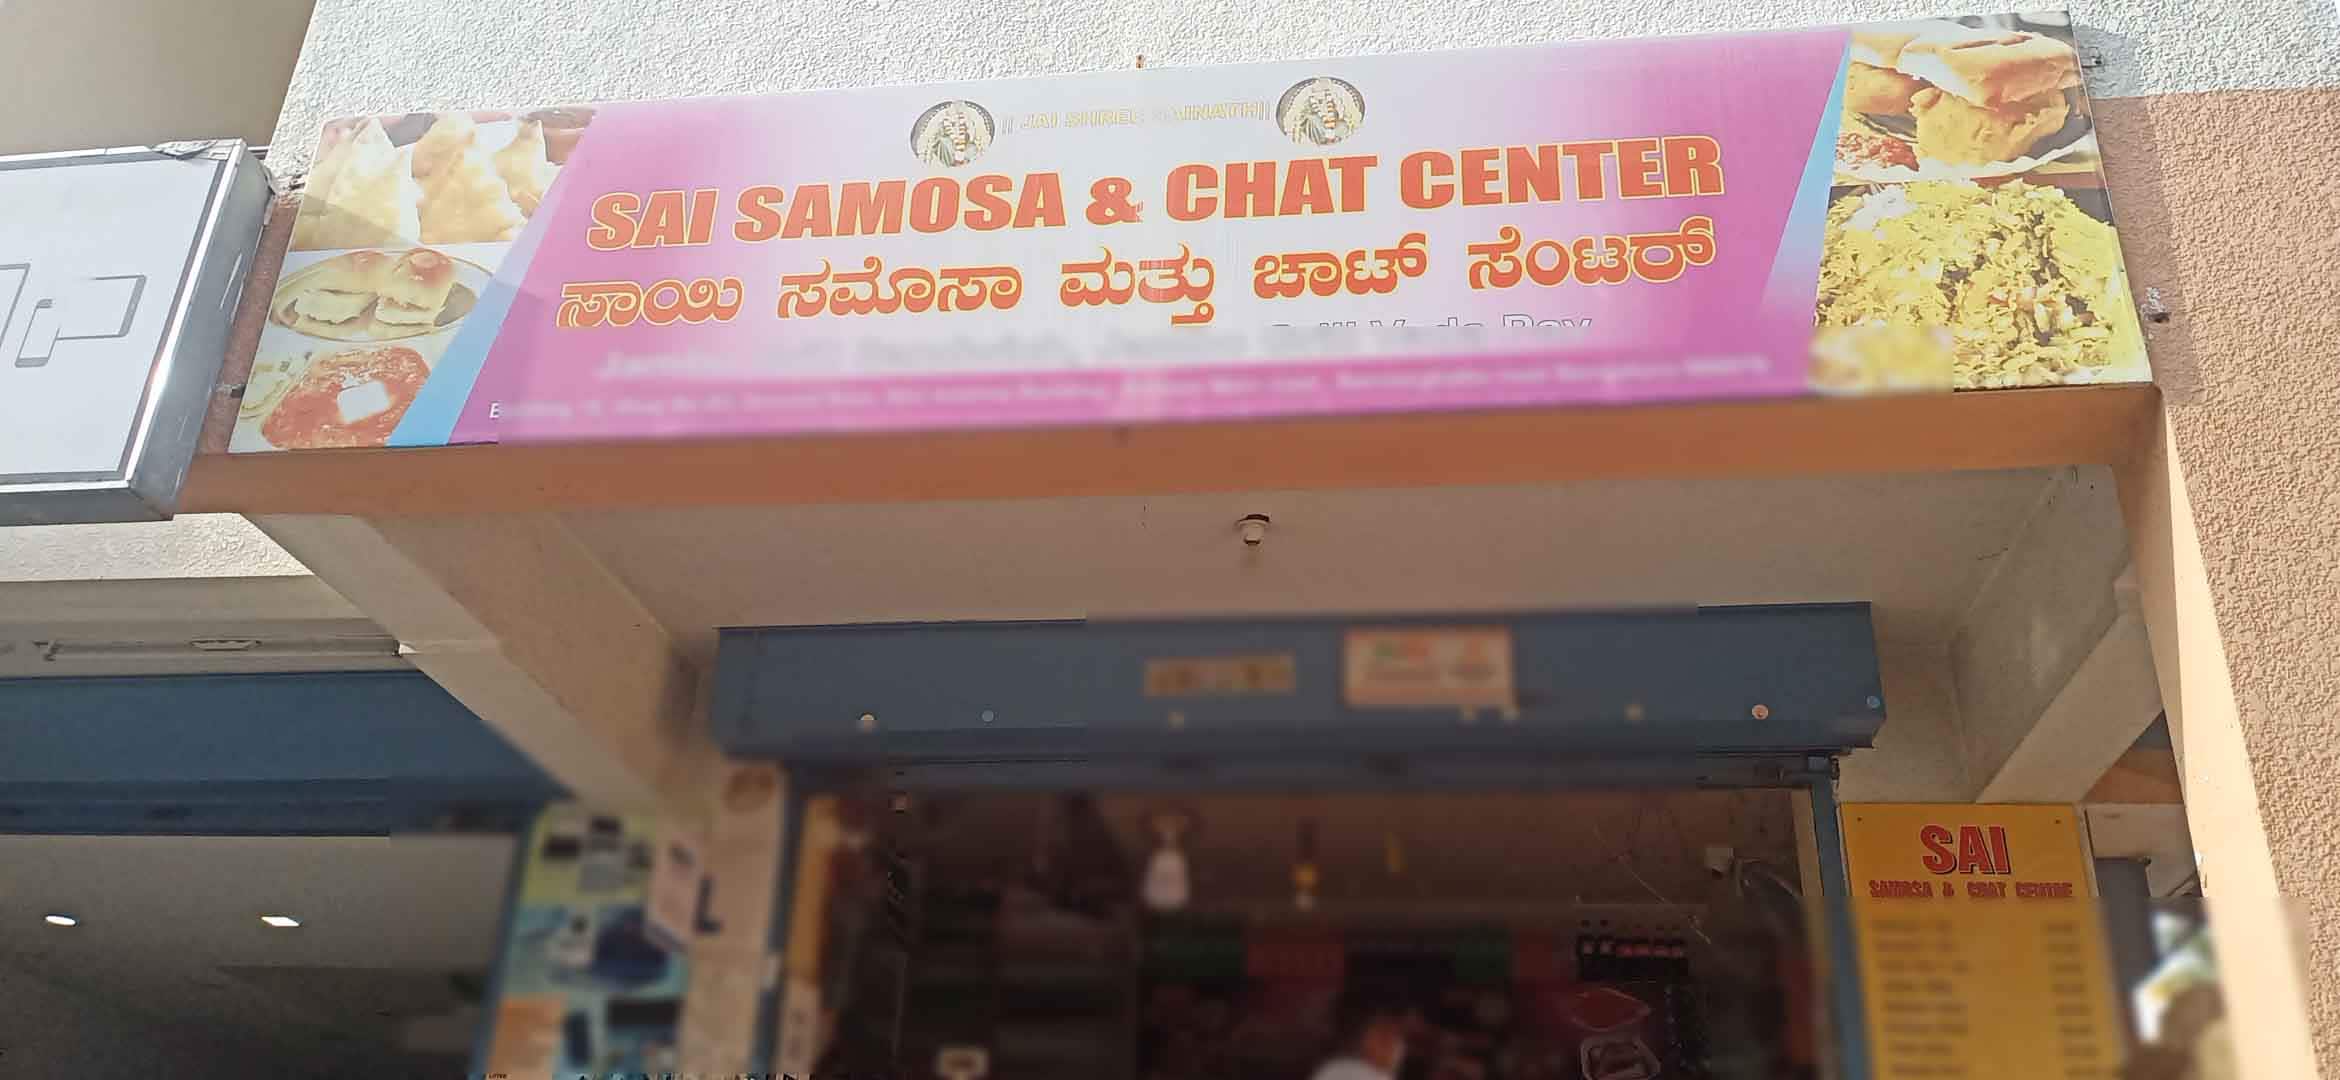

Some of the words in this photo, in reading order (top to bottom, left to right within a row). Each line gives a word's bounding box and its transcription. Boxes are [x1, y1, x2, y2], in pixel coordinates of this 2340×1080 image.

[587, 188, 718, 251] SAI
[734, 171, 1067, 244] SAMOSA
[1084, 175, 1145, 226] &
[1164, 153, 1379, 223] CHAT
[1399, 134, 1725, 211] CENTER
[556, 274, 744, 329] ಸಾಯಿ
[1058, 240, 1217, 327] ಮತ್ತು
[1252, 230, 1429, 300] ಚಾಟ್
[1467, 216, 1718, 291] ಸೆಂಟರ್
[1920, 823, 2012, 876] SAI
